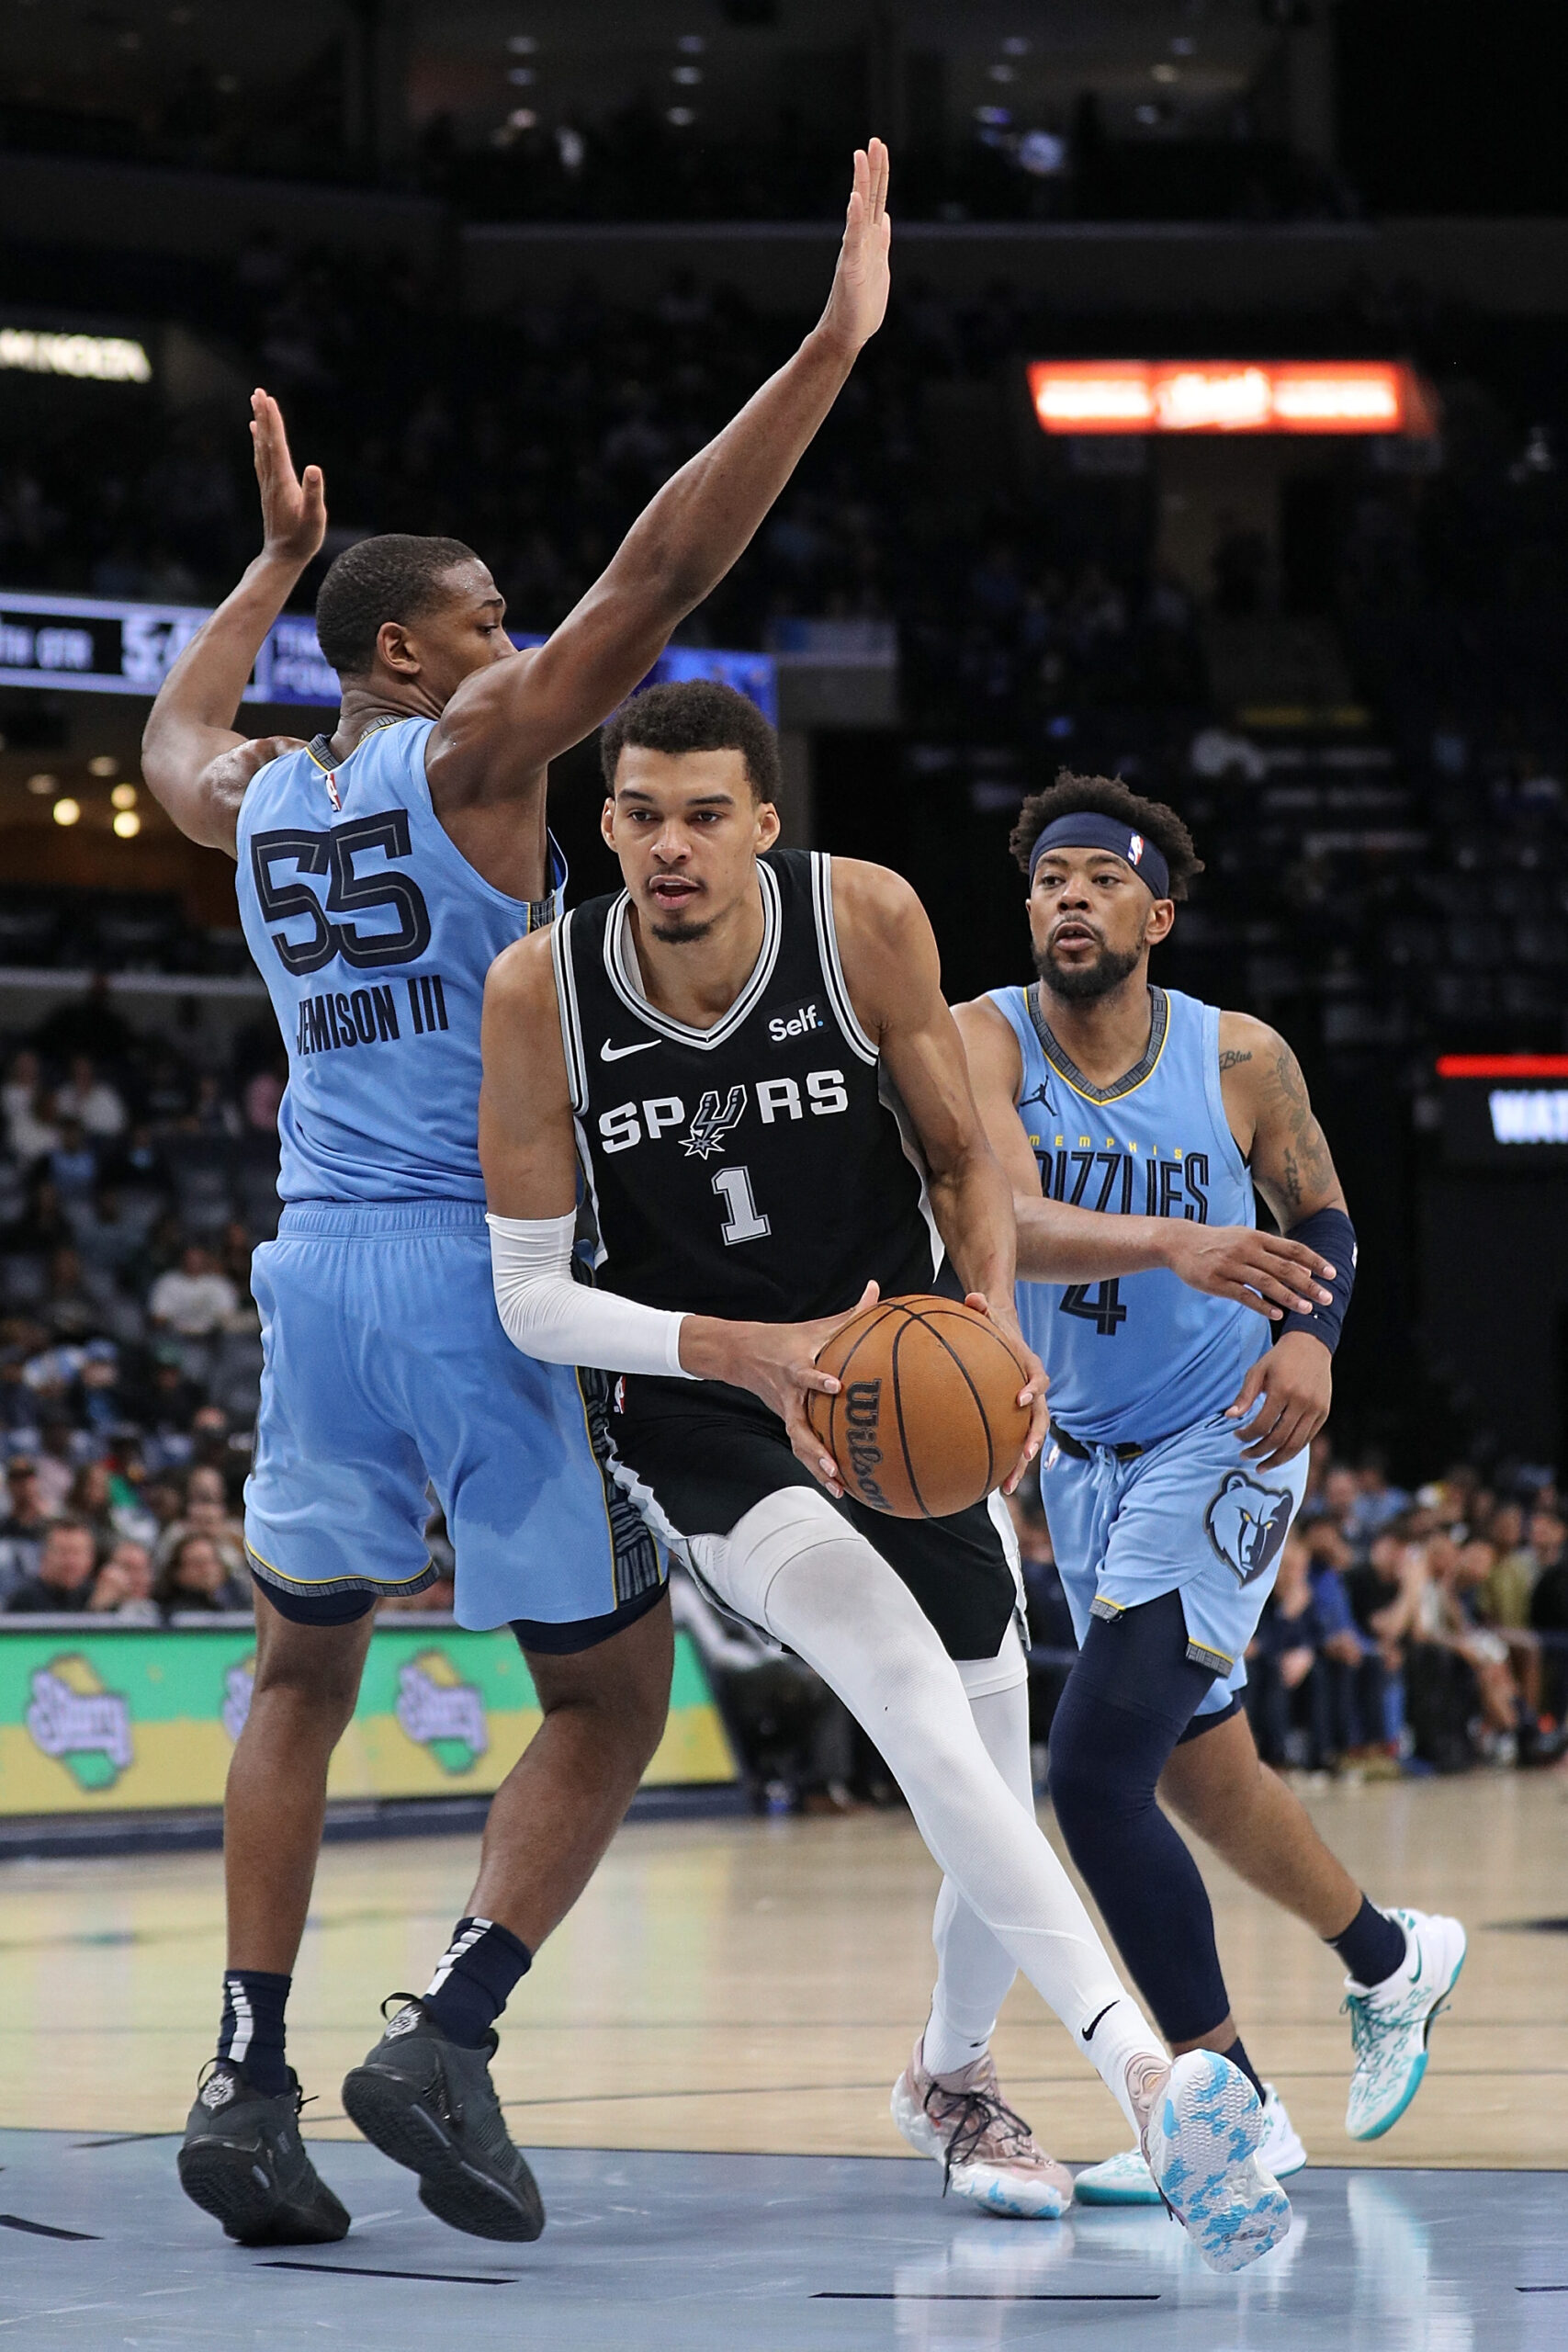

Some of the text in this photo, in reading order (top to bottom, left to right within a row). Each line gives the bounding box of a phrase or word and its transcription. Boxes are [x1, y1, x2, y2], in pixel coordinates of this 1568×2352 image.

[251, 808, 432, 977] 55
[297, 975, 449, 1057] JEMISON III
[1028, 1135, 1183, 1159] MEMPHIS
[711, 1166, 772, 1246] 1
[1059, 1278, 1127, 1336] 4
